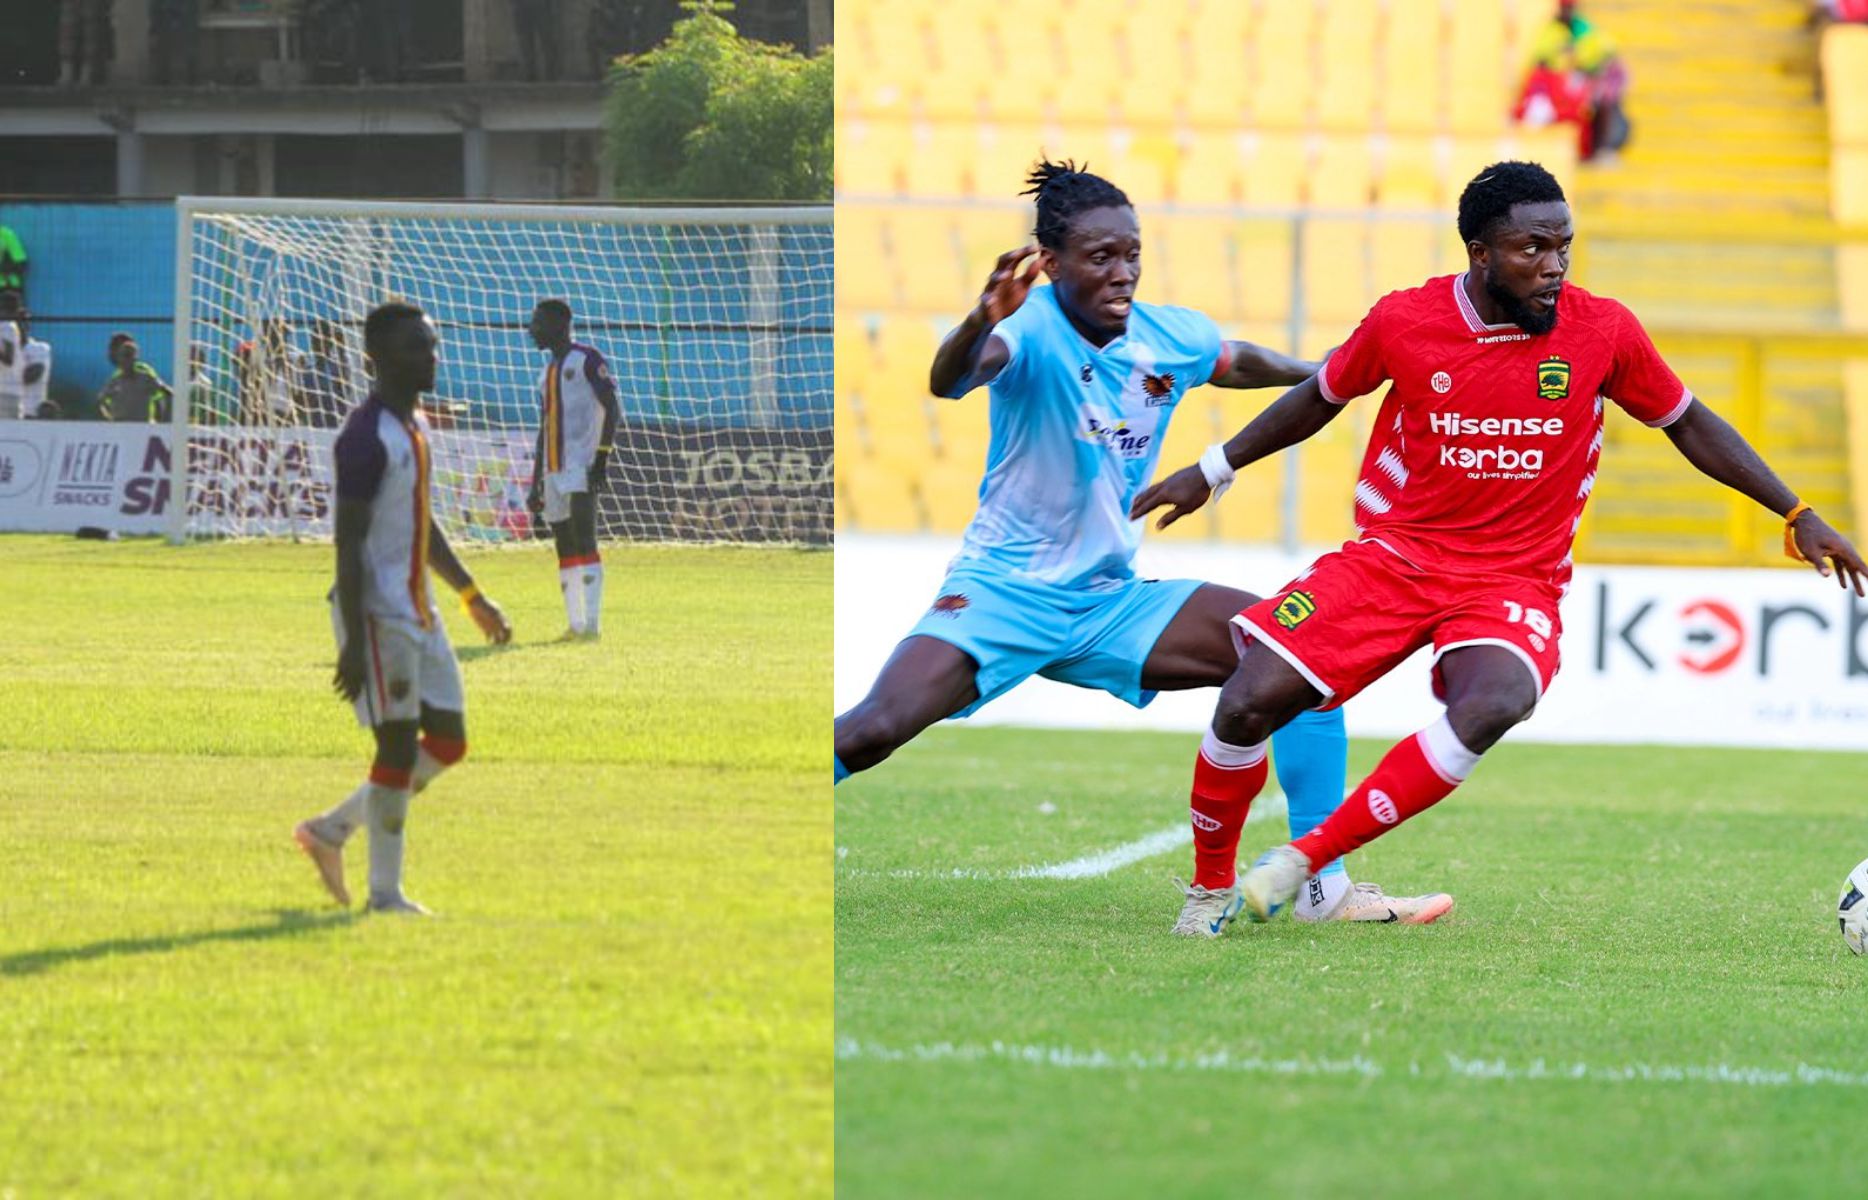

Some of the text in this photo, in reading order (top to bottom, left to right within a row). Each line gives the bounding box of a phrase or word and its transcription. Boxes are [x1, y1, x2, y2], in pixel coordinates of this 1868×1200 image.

[1429, 413, 1564, 436] Hisense
[1467, 471, 1480, 480] our
[53, 491, 112, 507] SNACKS
